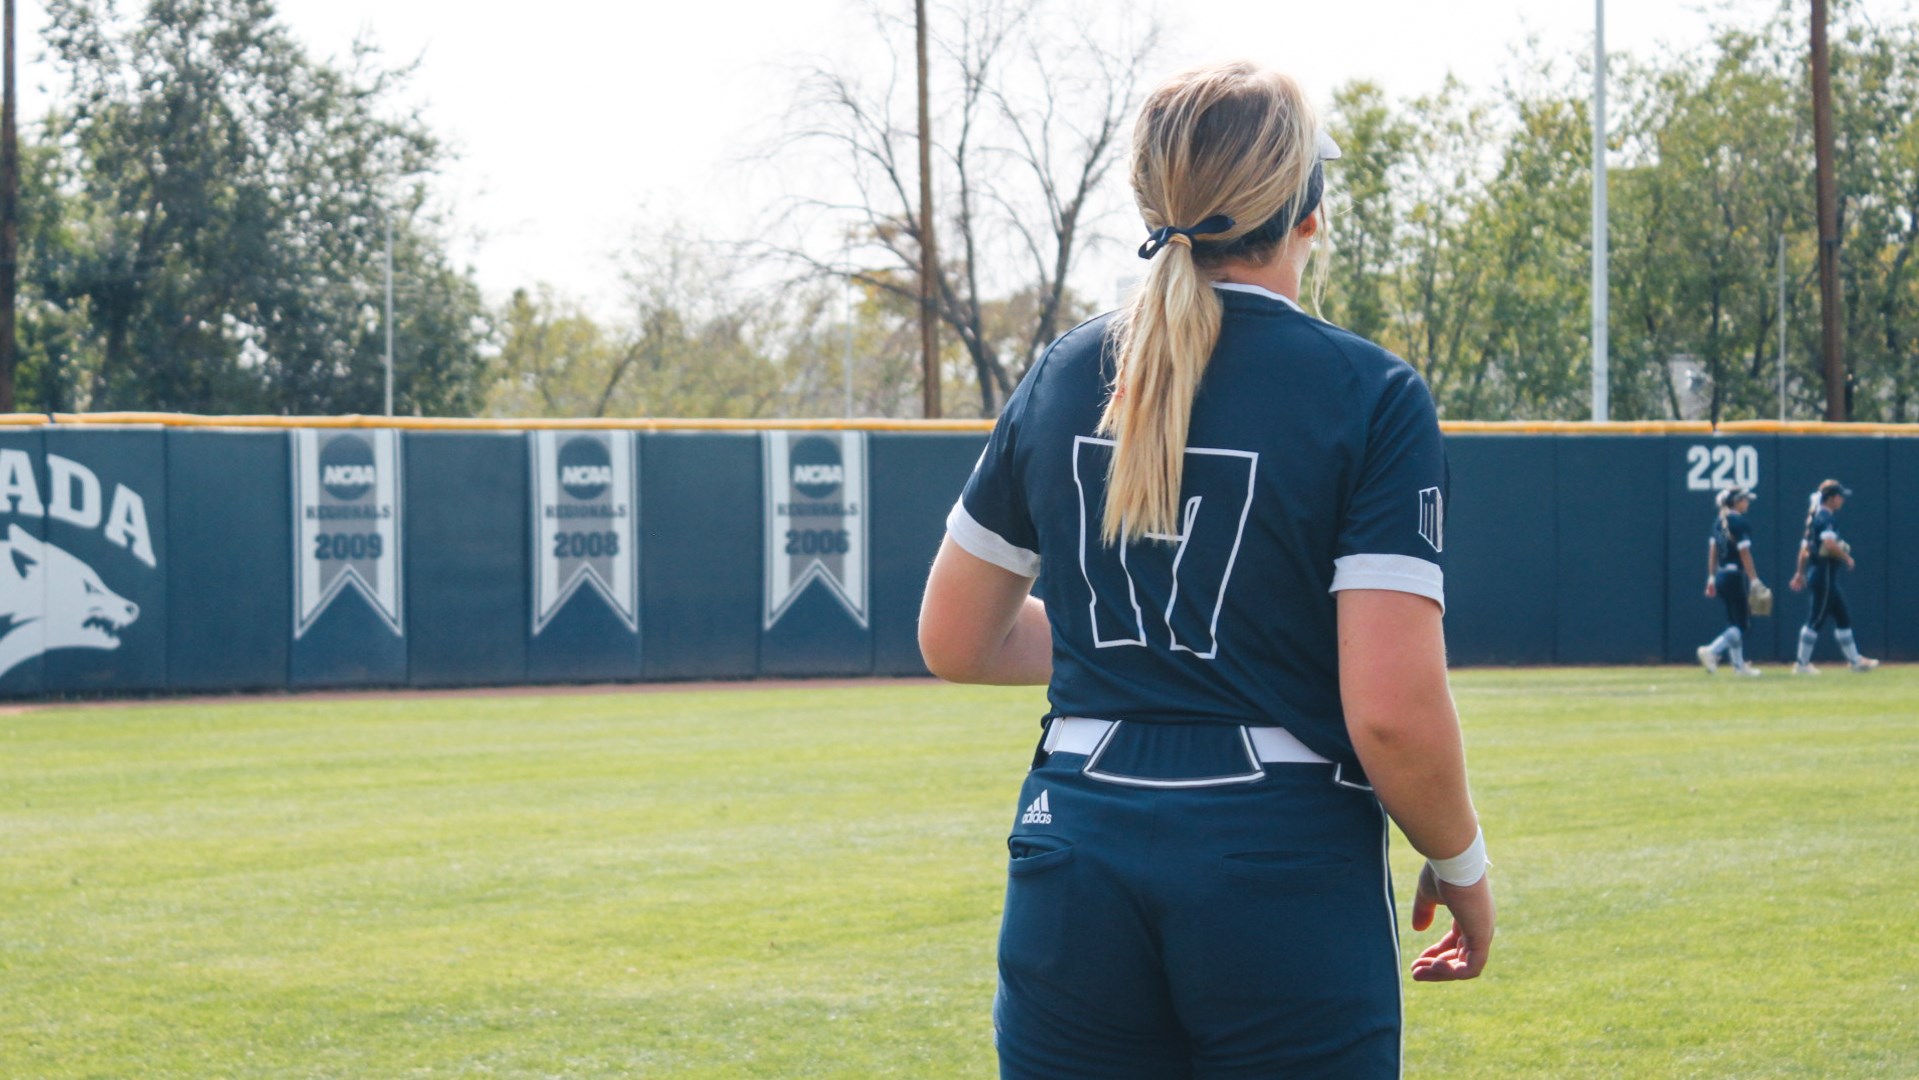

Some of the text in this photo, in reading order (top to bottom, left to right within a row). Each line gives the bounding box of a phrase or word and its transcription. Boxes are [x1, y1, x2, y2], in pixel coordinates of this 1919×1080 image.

[324, 464, 374, 485] NCAA
[561, 464, 611, 485] NCAA
[793, 464, 843, 484] NCAA
[1687, 445, 1759, 490] 220
[314, 532, 383, 560] 2009
[553, 531, 619, 558] 2008
[785, 529, 850, 555] 2006
[1022, 810, 1053, 824] adidas
